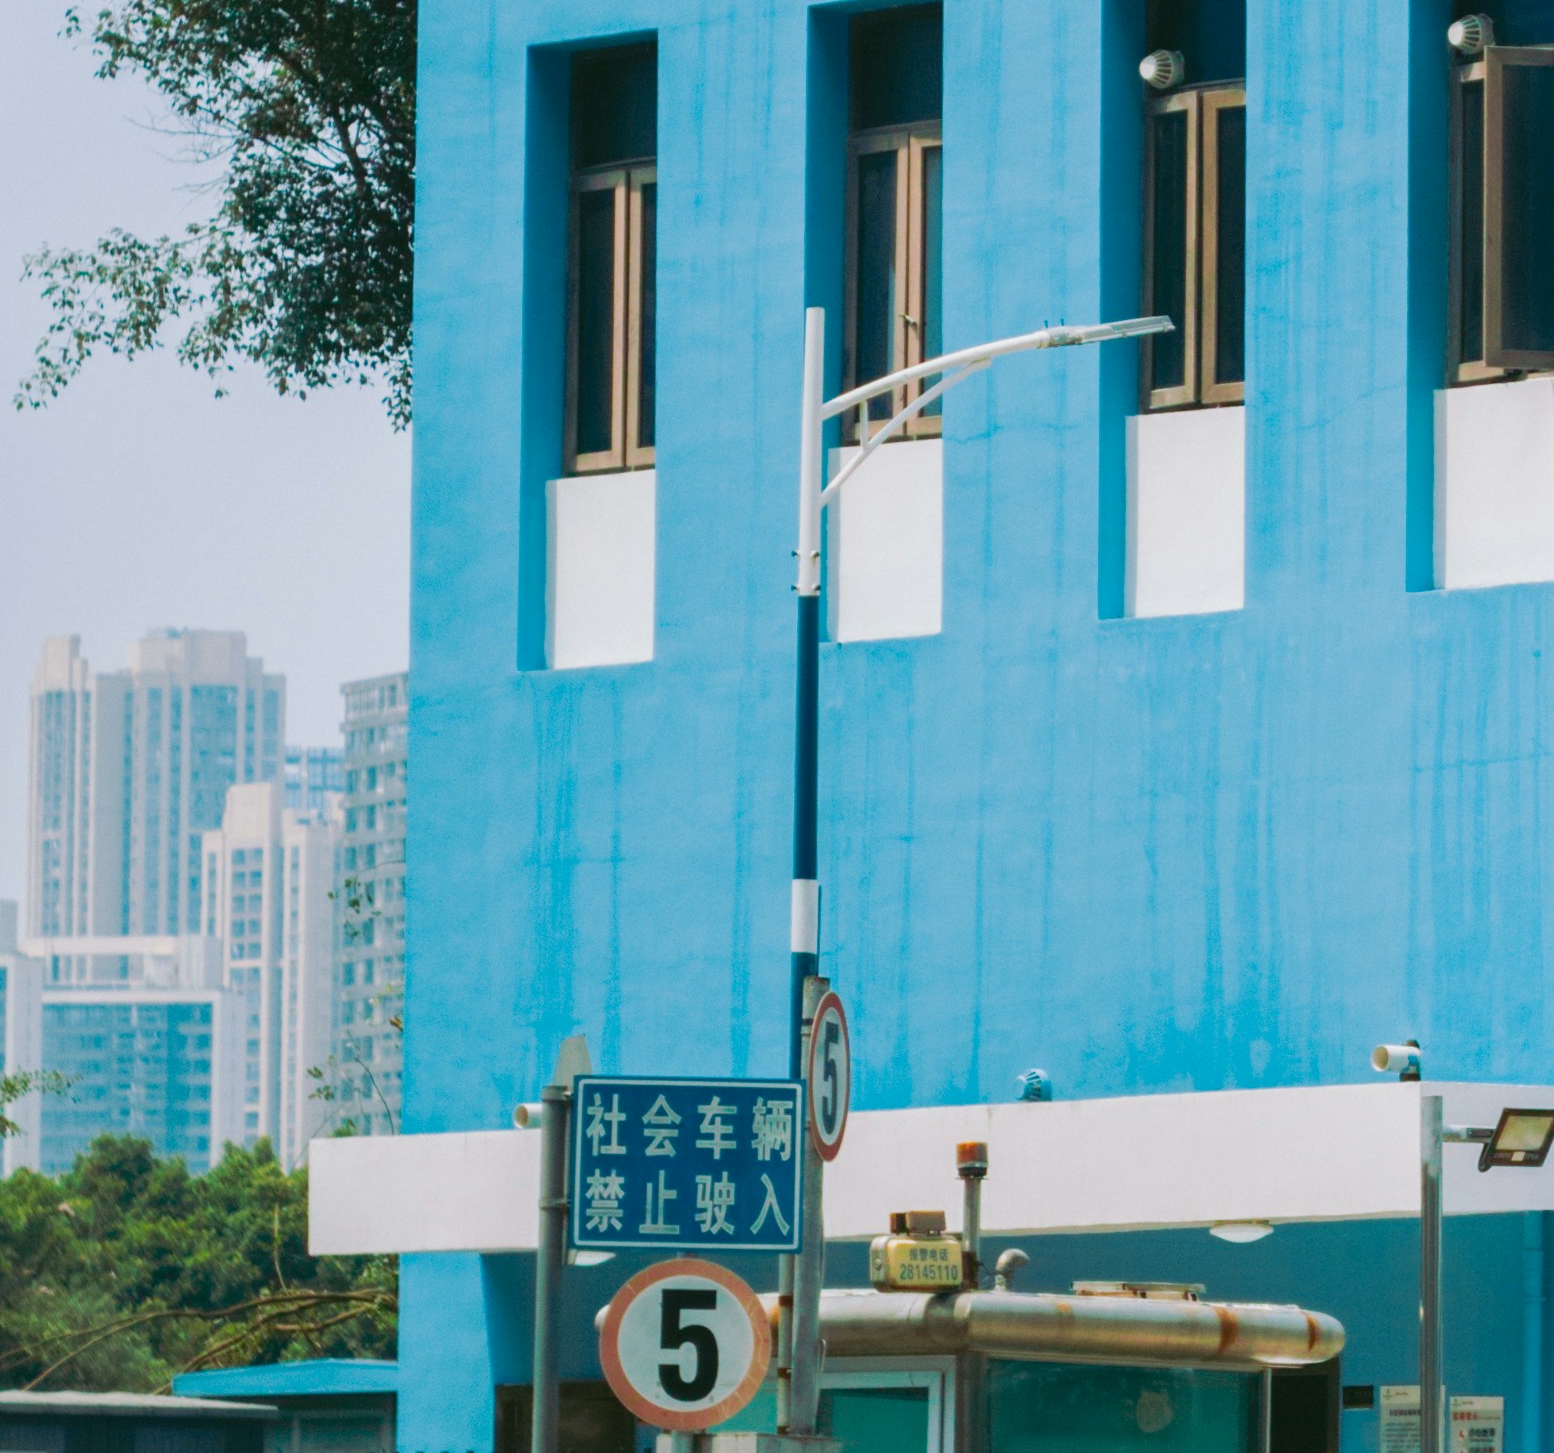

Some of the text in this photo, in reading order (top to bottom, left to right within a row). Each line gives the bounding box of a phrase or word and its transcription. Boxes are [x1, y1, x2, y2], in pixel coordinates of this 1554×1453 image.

[820, 1021, 841, 1136] 5
[586, 1092, 794, 1161] 社会车辆
[585, 1169, 790, 1237] 禁止驶入
[899, 1264, 958, 1281] 28145110
[658, 1289, 719, 1403] 5
